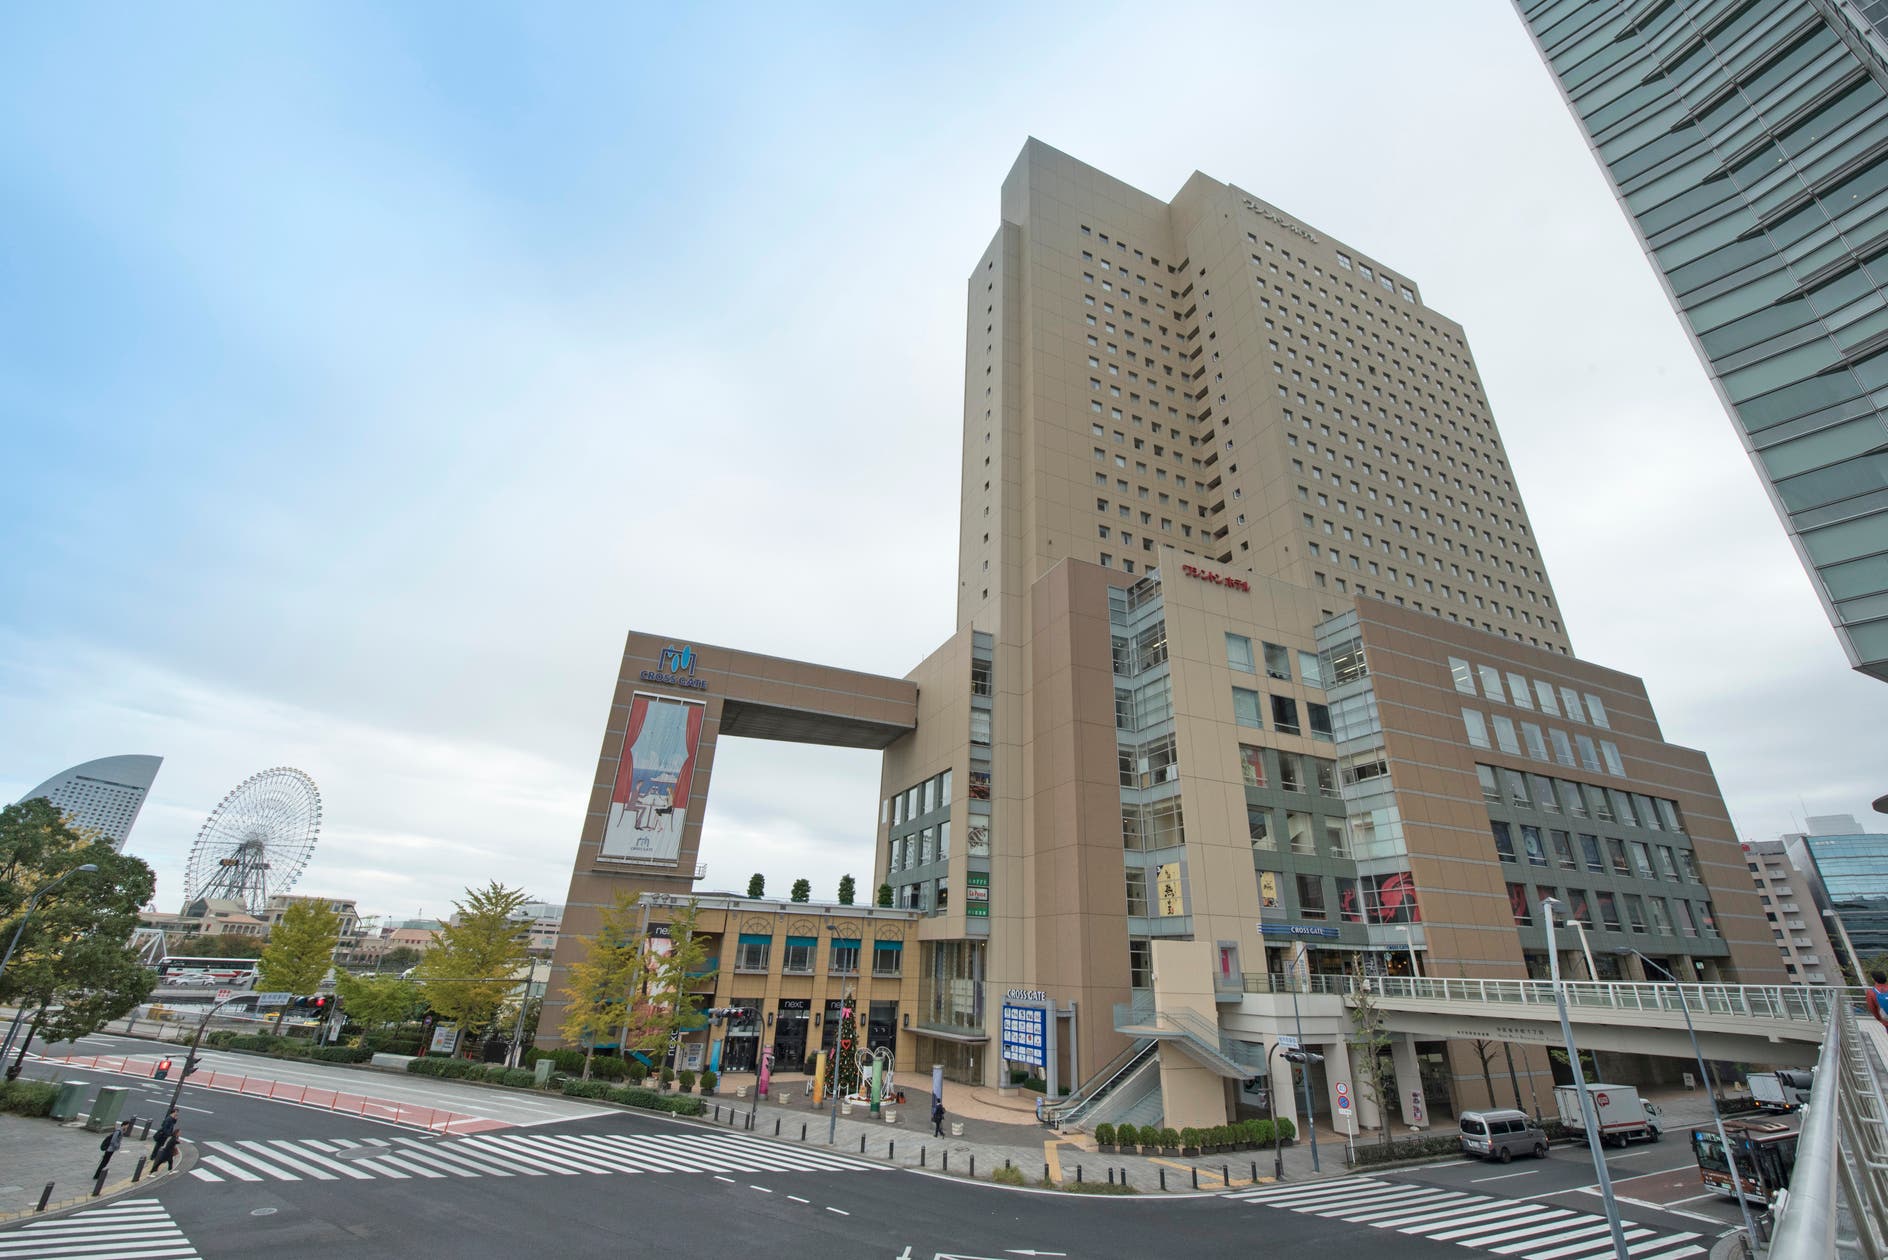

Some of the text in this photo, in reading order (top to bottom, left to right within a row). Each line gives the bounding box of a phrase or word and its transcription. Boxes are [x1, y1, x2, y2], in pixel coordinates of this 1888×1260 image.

[640, 670, 708, 689] CROSS GATE
[1290, 926, 1323, 936] CROSS GATE
[1007, 988, 1046, 1001] CROSS GATE
[784, 1001, 804, 1009] next
